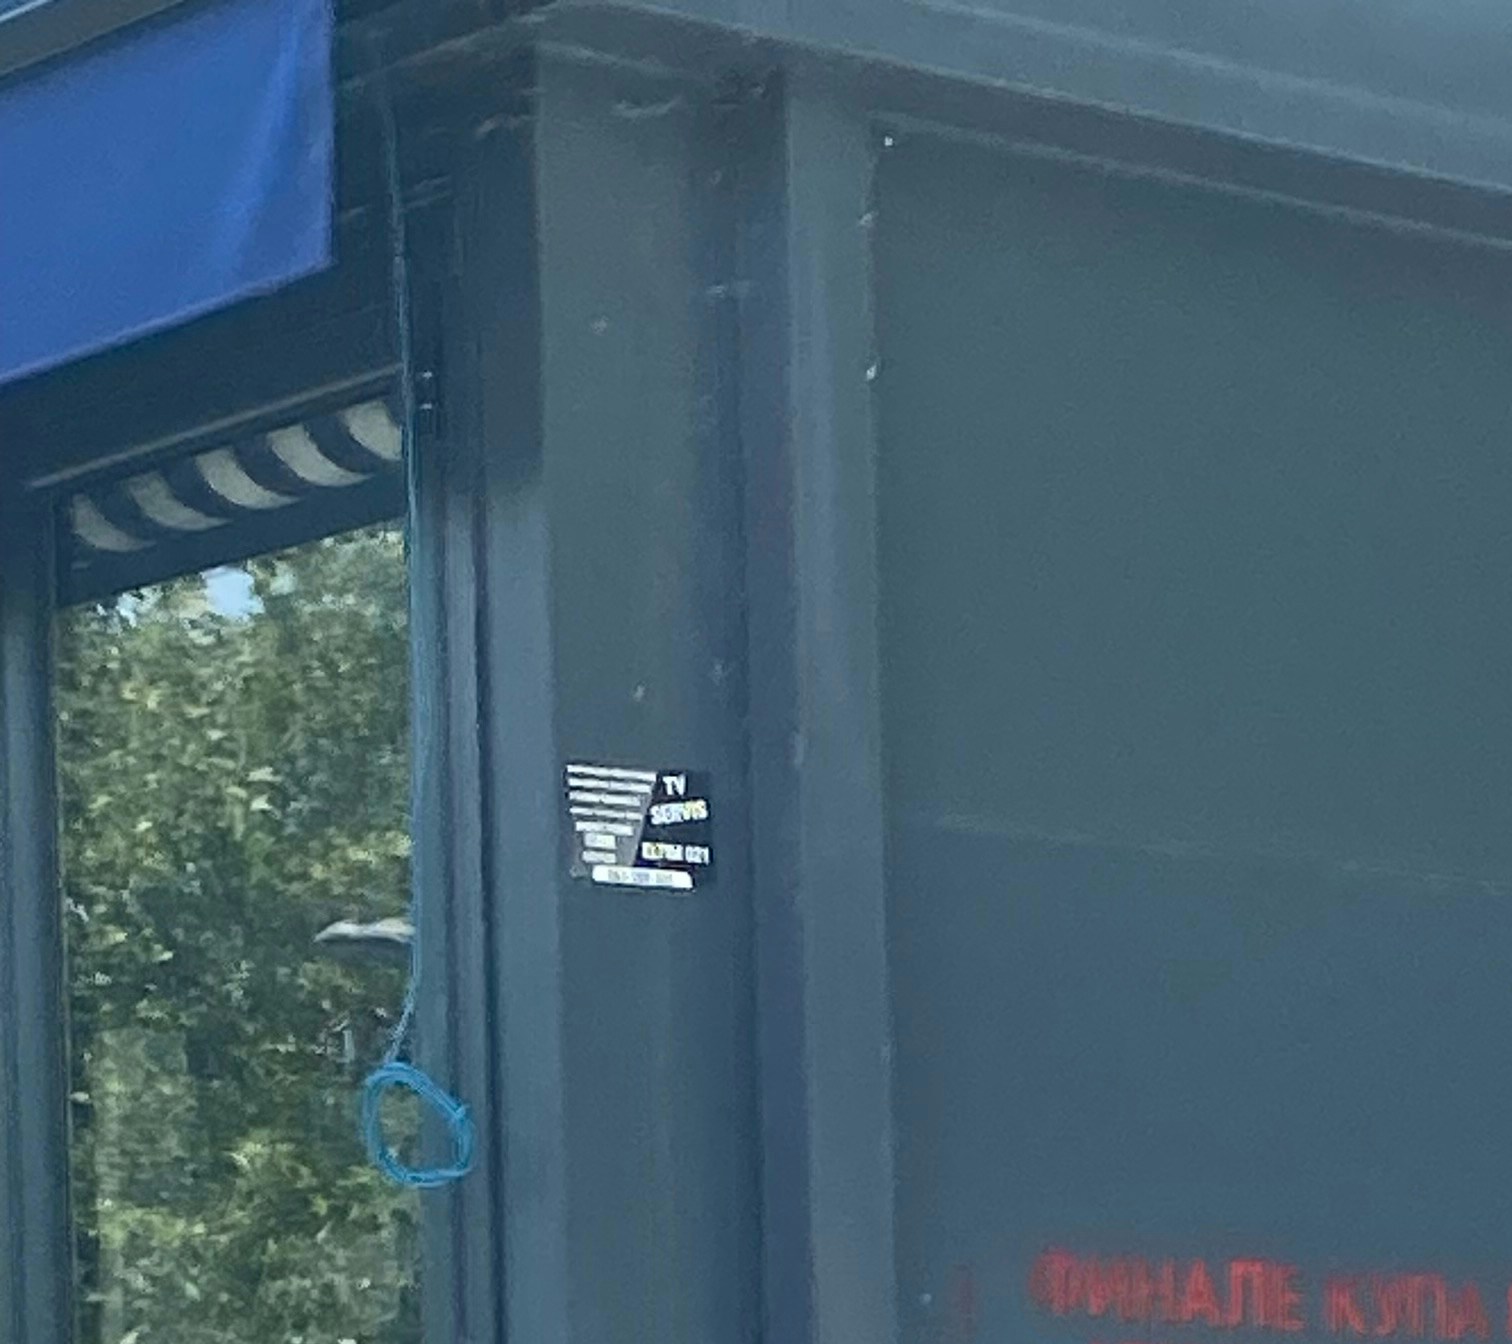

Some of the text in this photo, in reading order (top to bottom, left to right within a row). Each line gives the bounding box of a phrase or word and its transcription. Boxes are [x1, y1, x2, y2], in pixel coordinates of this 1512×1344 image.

[662, 775, 688, 796] TV
[649, 799, 708, 826] SERVIS
[1031, 1249, 1304, 1331] ФИНАЛЕ
